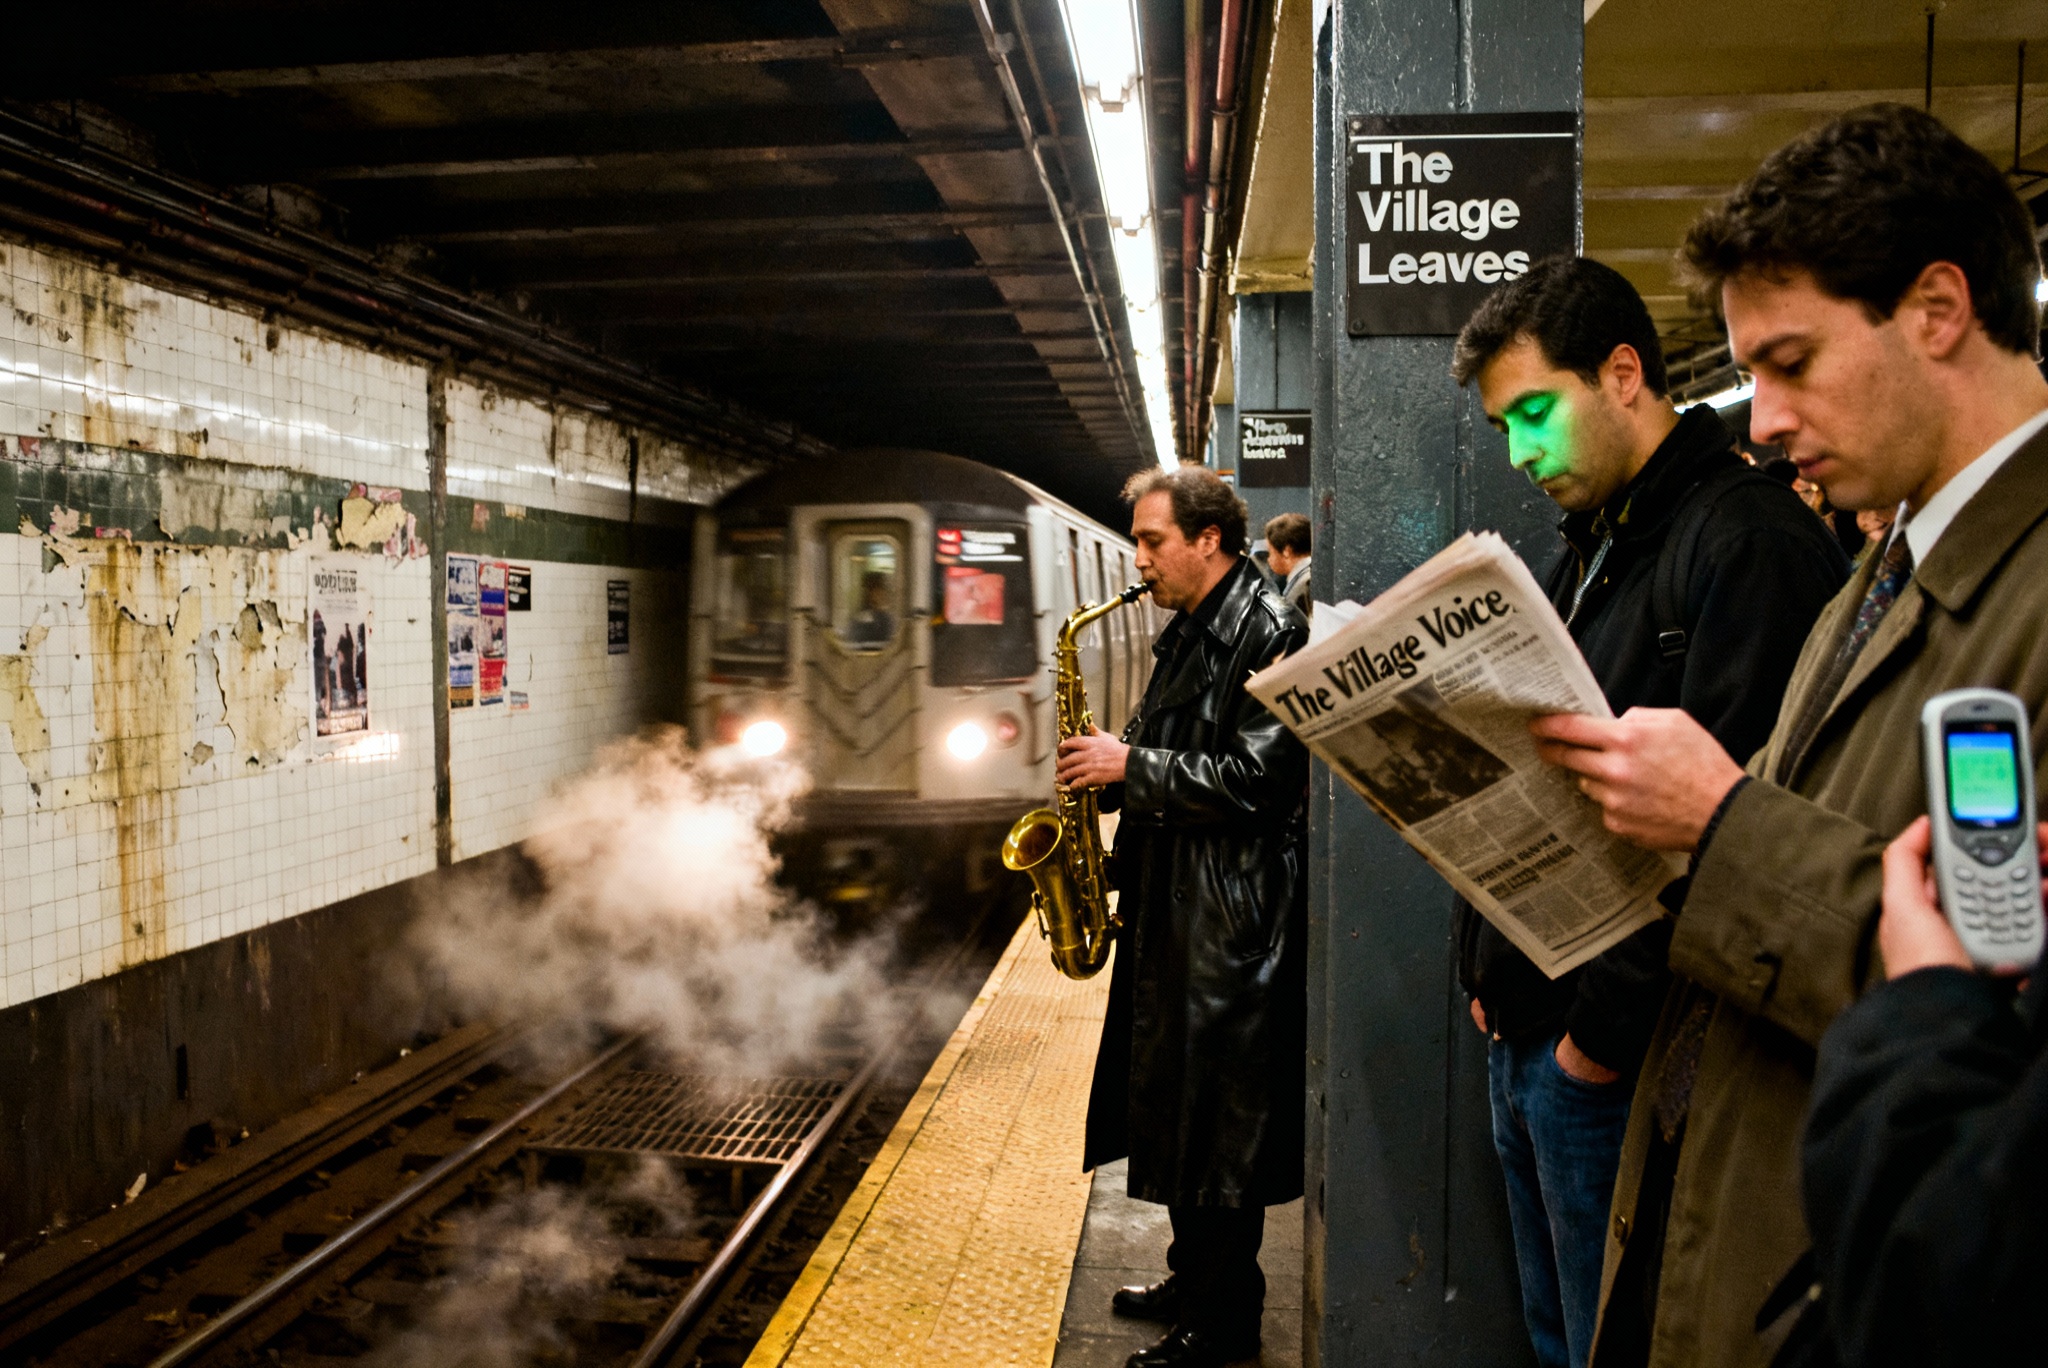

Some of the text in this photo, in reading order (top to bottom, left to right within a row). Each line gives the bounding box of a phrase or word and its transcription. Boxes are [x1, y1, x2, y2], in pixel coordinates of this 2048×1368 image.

[1357, 141, 1453, 185] The
[1356, 189, 1521, 241] Village
[1358, 243, 1530, 284] Leaves
[1275, 685, 1336, 726] The
[1322, 634, 1427, 699] Village
